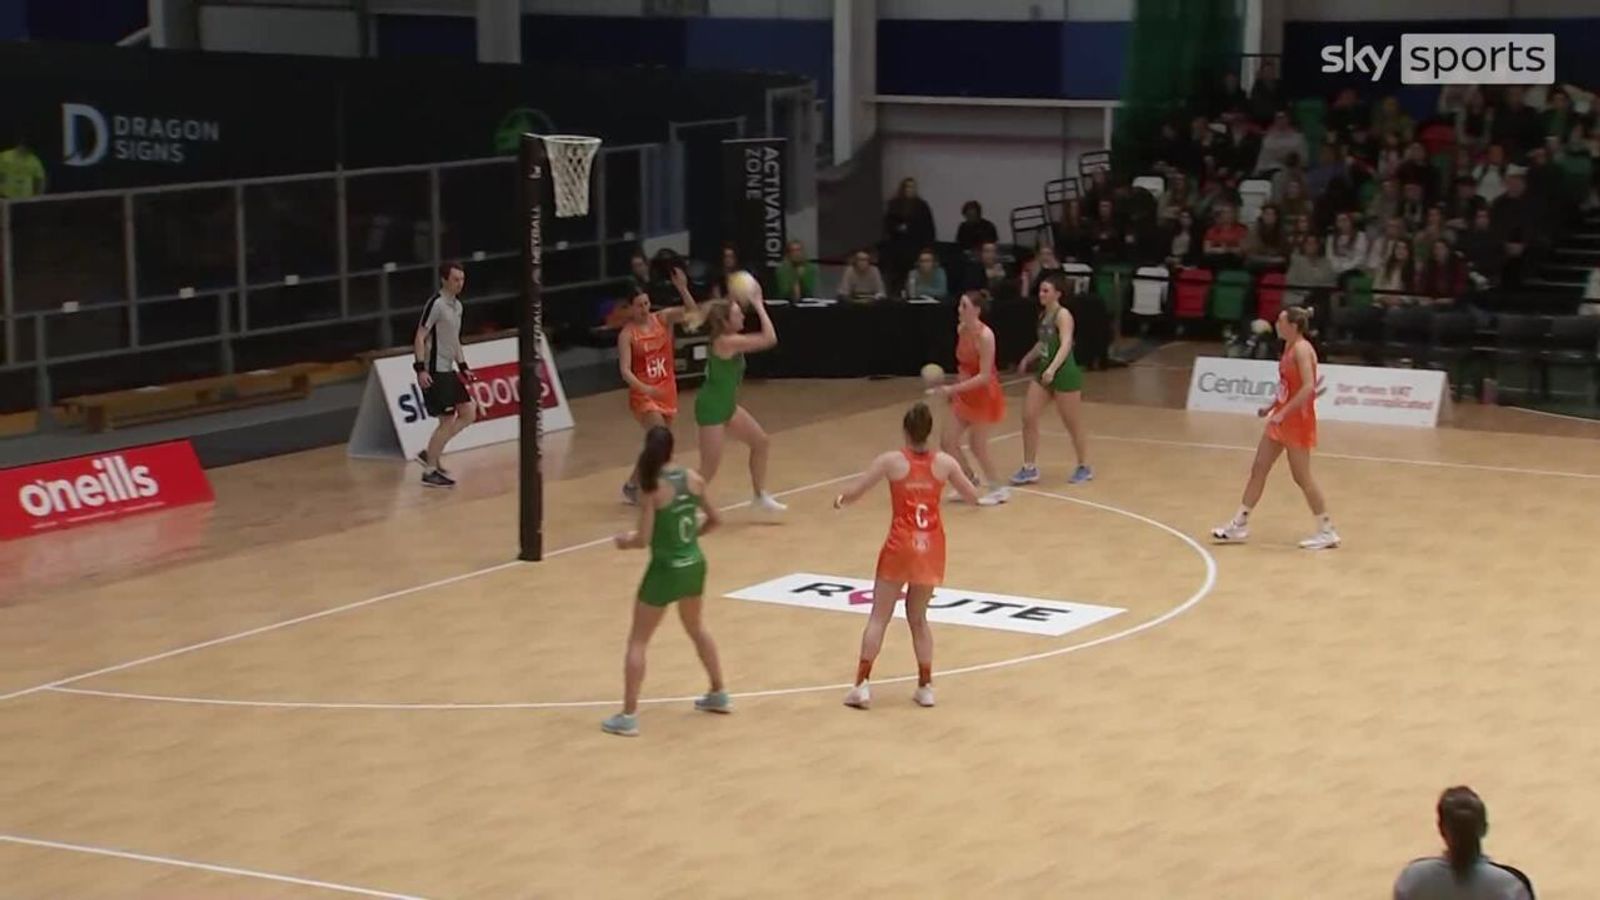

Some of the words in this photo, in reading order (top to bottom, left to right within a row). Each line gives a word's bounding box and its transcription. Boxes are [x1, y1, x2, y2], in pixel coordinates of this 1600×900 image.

[114, 115, 220, 141] DRAGON
[115, 139, 185, 163] SIGNS
[745, 149, 763, 199] ZONE
[763, 146, 782, 268] ACTIVATION
[646, 357, 667, 378] GK
[914, 503, 929, 529] C
